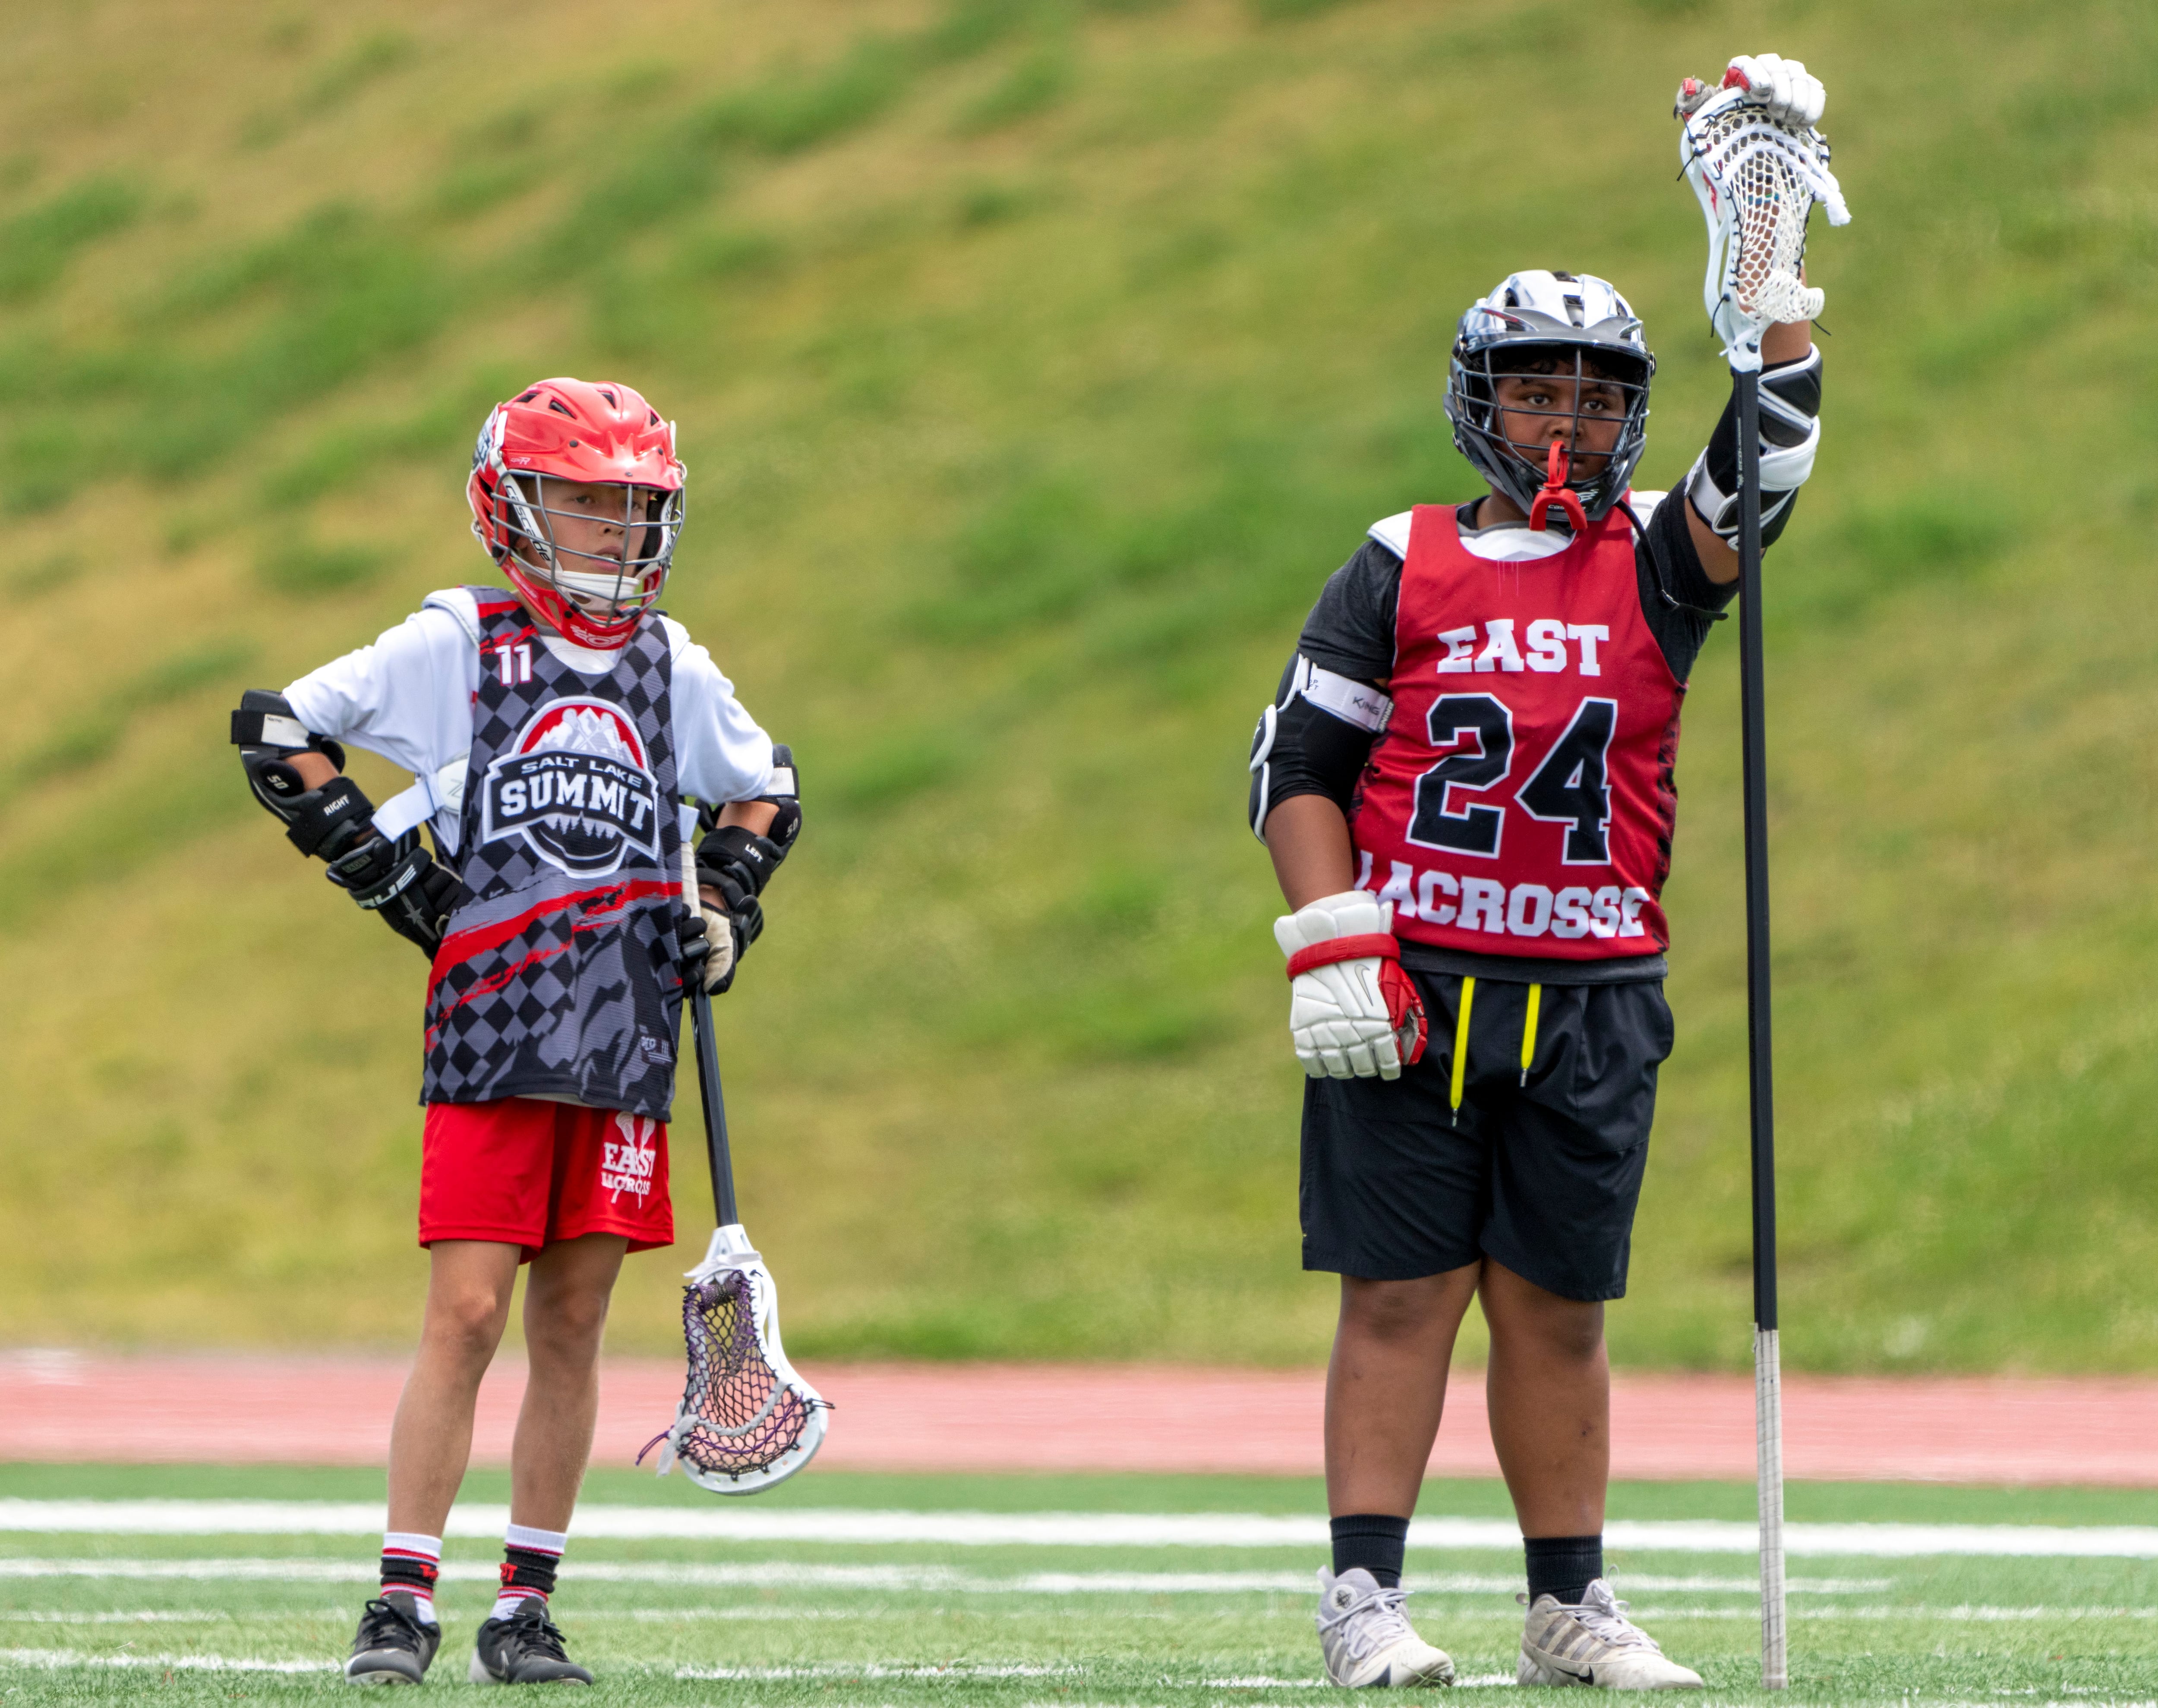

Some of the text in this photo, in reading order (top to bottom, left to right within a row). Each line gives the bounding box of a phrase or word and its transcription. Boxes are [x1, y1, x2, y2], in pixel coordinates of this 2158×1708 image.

[495, 642, 533, 687] 11
[1437, 618, 1609, 676] EAST
[521, 756, 642, 788] SALT LAKE
[1404, 692, 1618, 866] 24
[324, 794, 350, 816] RIGHT
[500, 770, 653, 831] SUMMIT
[745, 843, 764, 863] LEFT
[1353, 849, 1650, 938] LACROSSE
[601, 1141, 656, 1179] EAST
